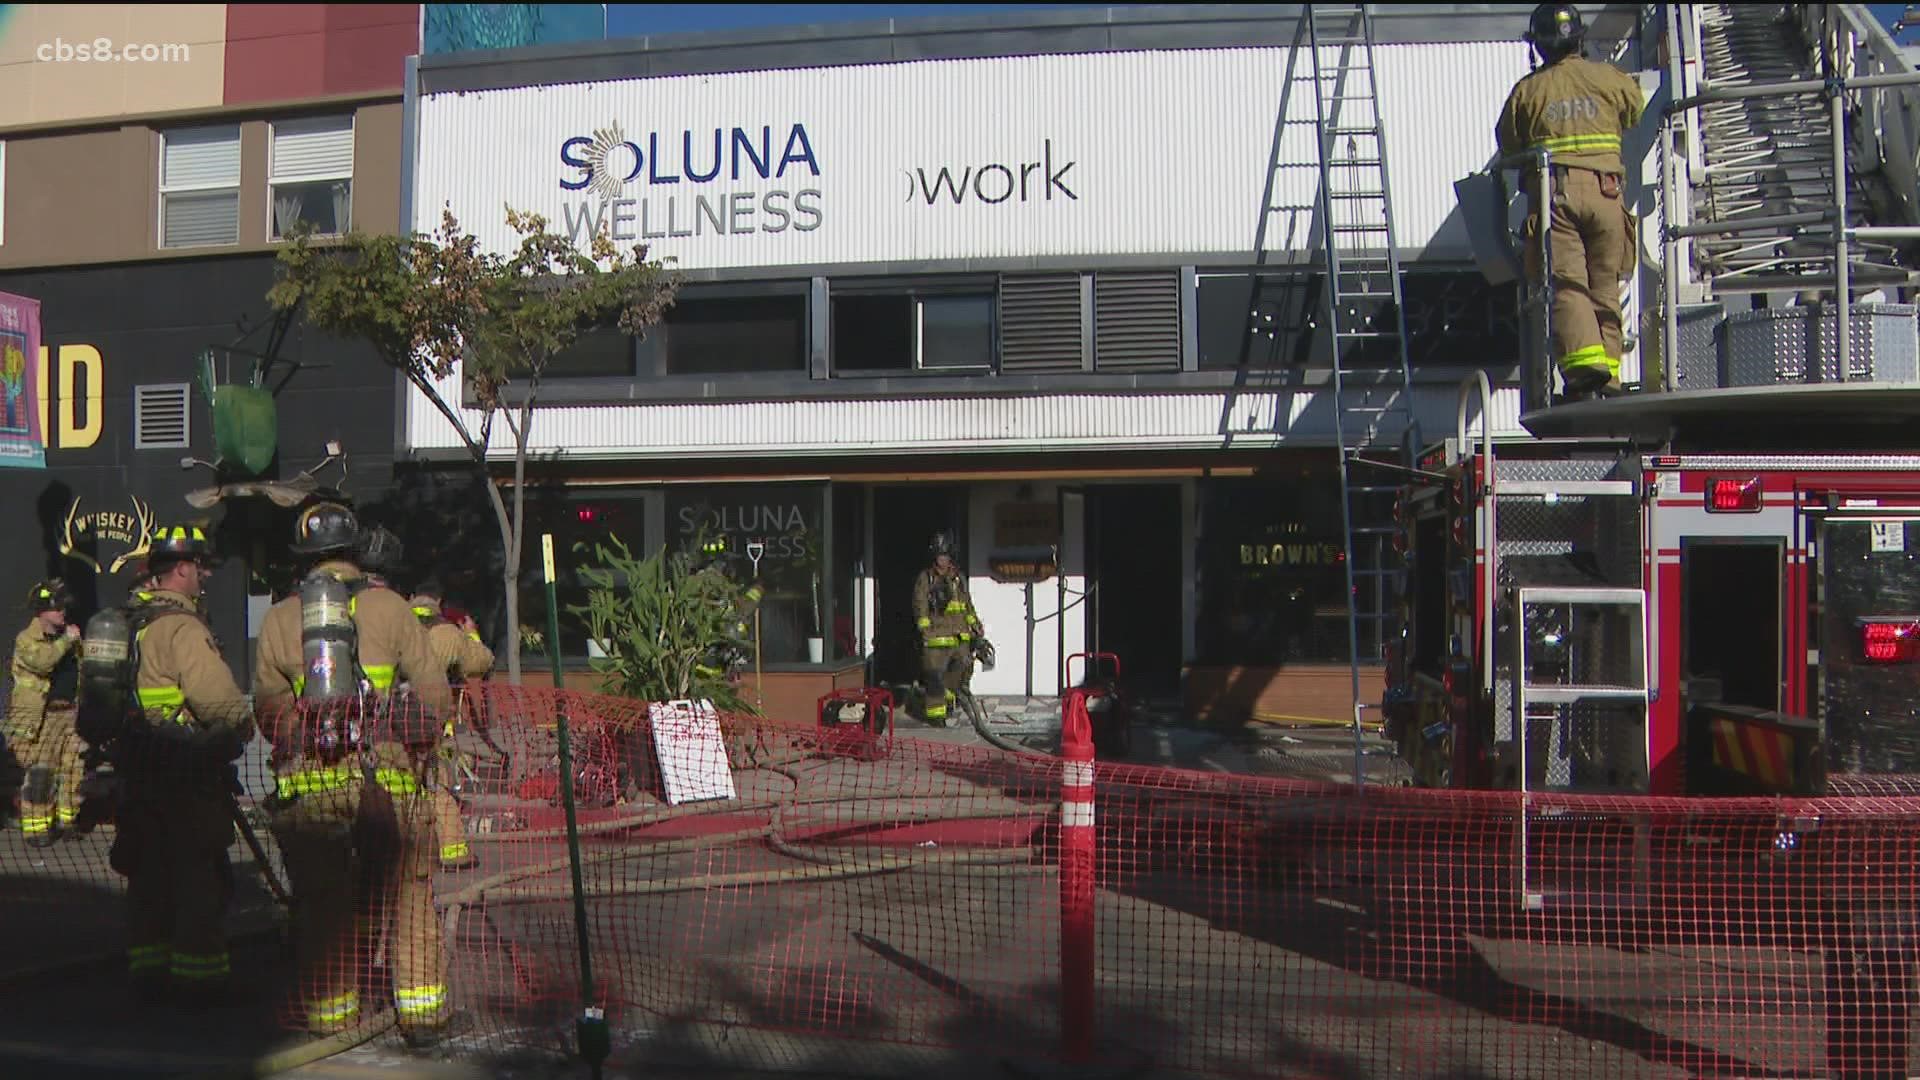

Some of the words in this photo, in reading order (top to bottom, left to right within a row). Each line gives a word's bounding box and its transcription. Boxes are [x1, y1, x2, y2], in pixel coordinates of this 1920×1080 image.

[559, 122, 820, 191] SOLUNA
[562, 188, 823, 242] WELLNESS
[679, 503, 808, 534] SOLUNA
